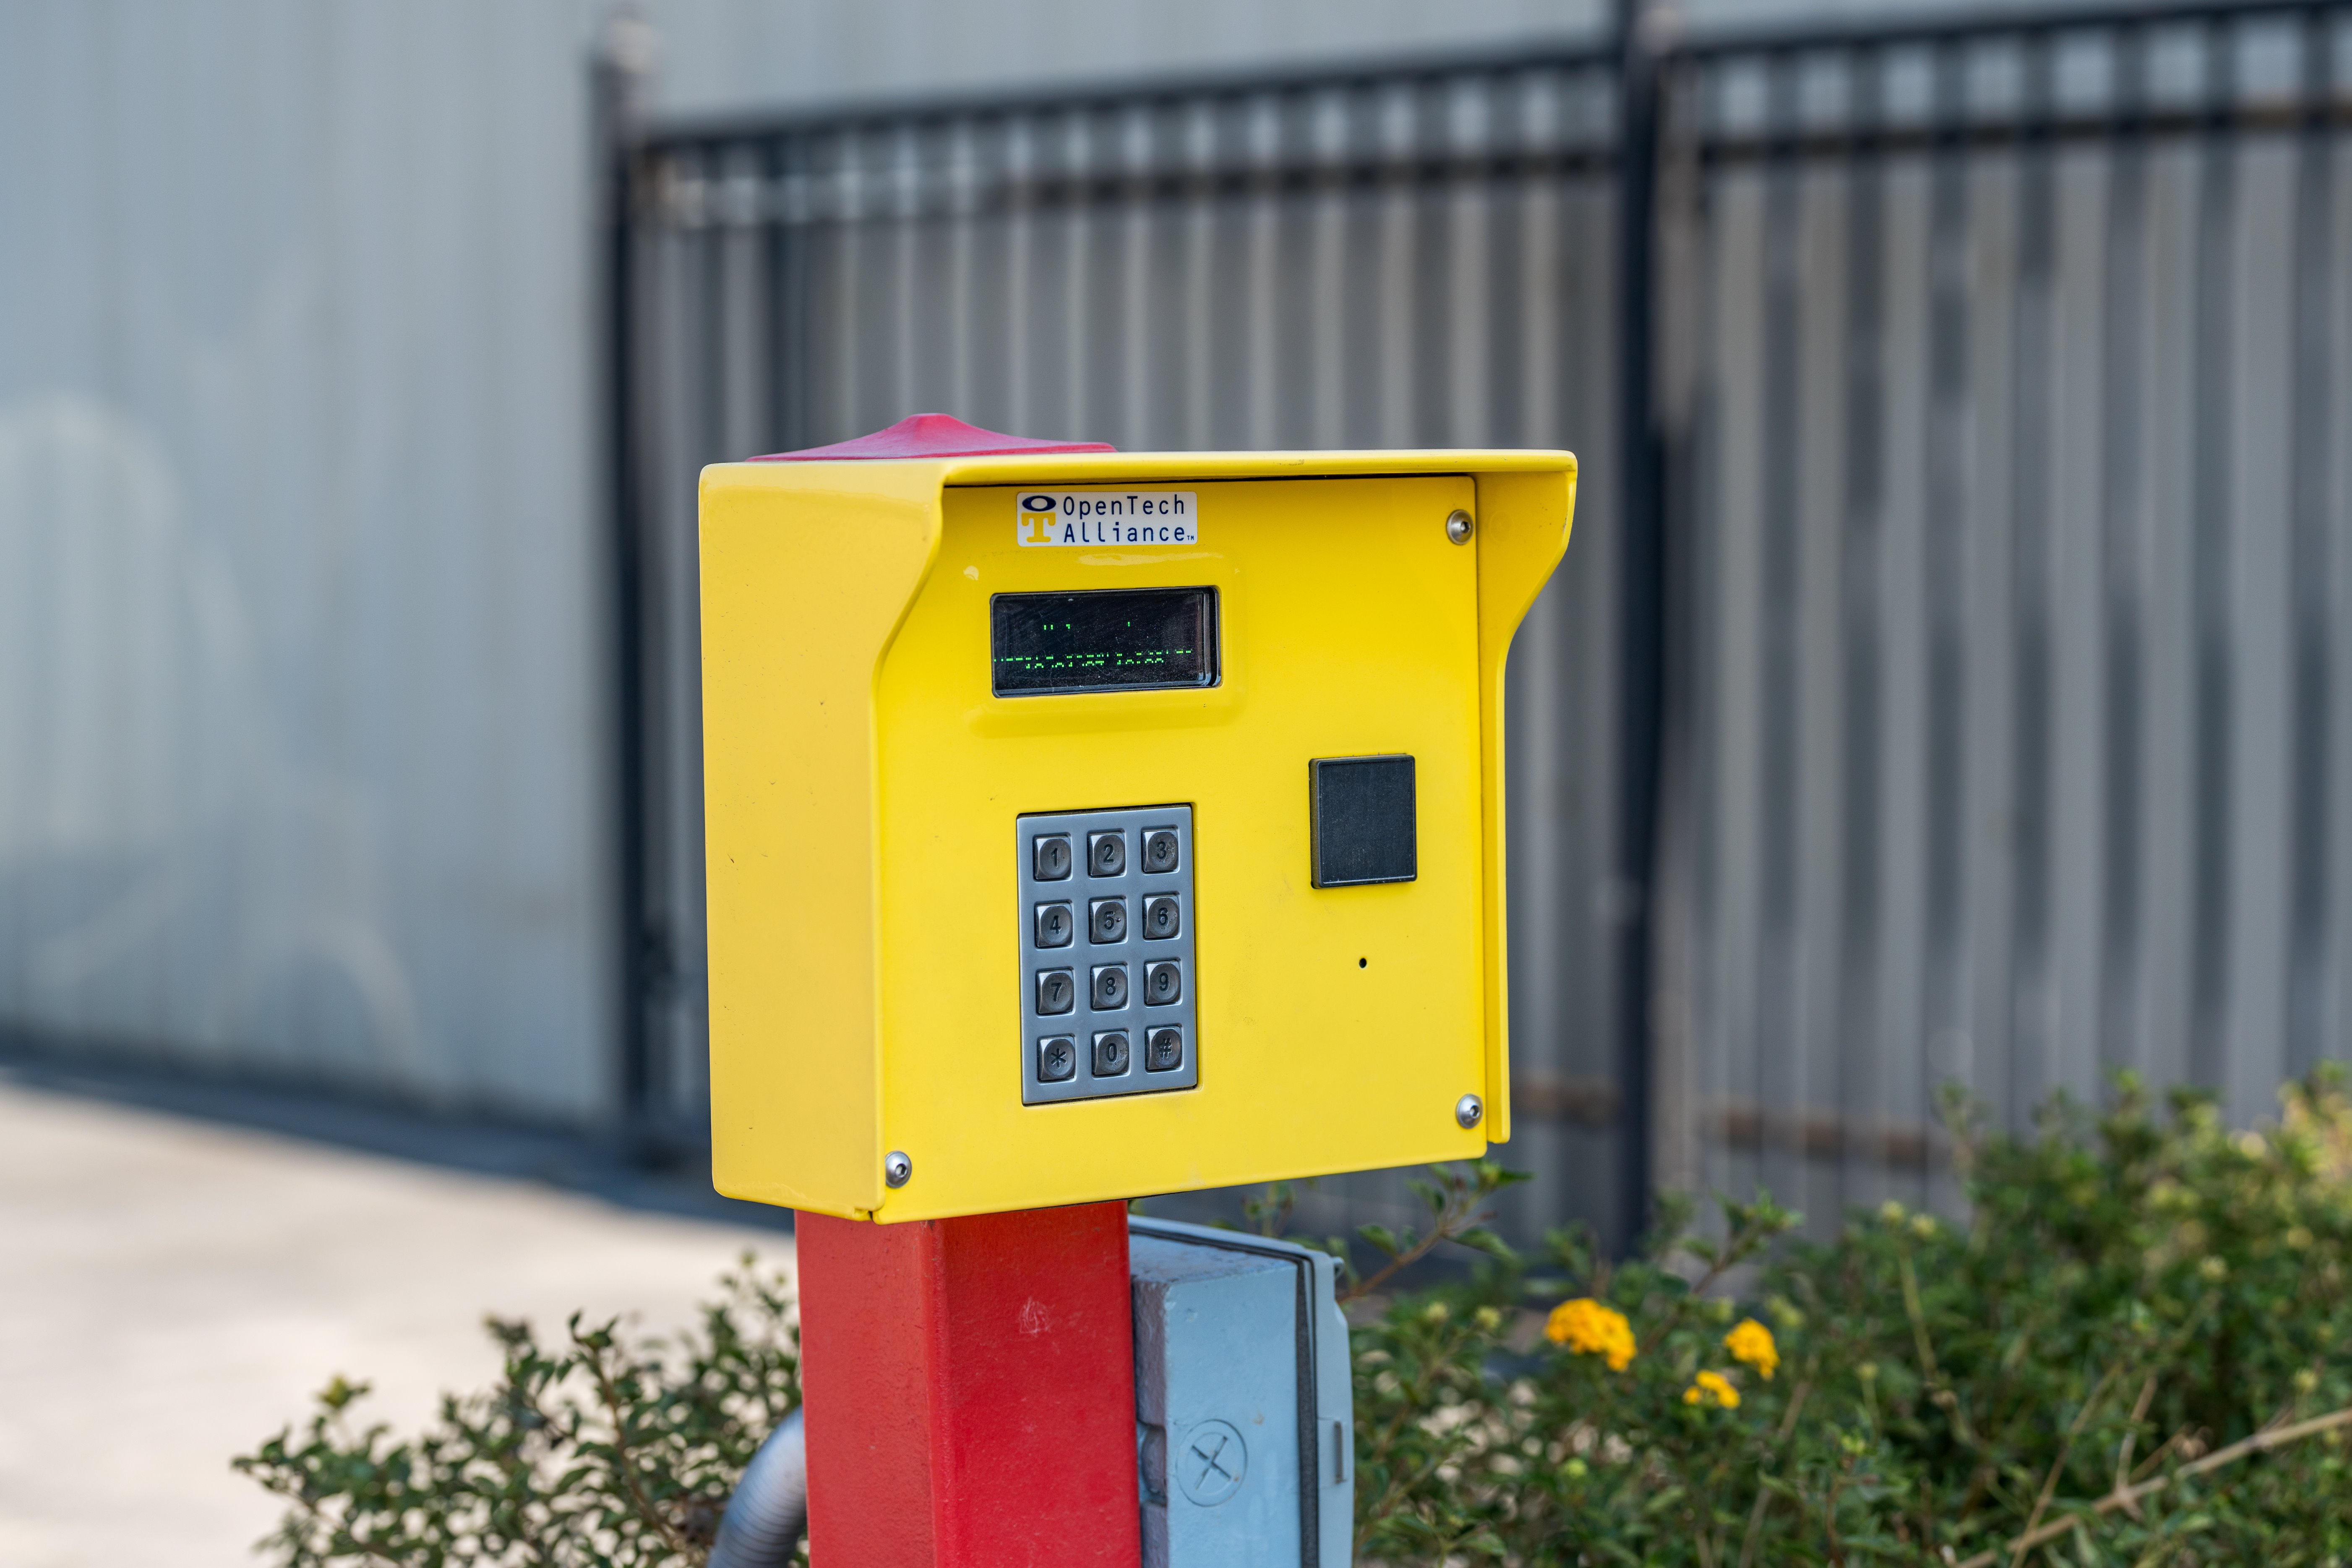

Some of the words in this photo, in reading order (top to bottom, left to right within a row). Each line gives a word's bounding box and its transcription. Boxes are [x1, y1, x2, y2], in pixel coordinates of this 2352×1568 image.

[1063, 494, 1184, 519] OpenTech
[1064, 522, 1184, 543] Alliance
[1051, 848, 1059, 868] 1
[1103, 844, 1114, 863] 2
[1157, 841, 1167, 860] 3
[1050, 915, 1061, 934] 4
[1104, 911, 1115, 930] 5
[1158, 908, 1168, 926] 6
[1051, 982, 1062, 1003] 7
[1105, 977, 1116, 997] 8
[1158, 972, 1170, 993] 9
[1106, 1043, 1118, 1062] 0
